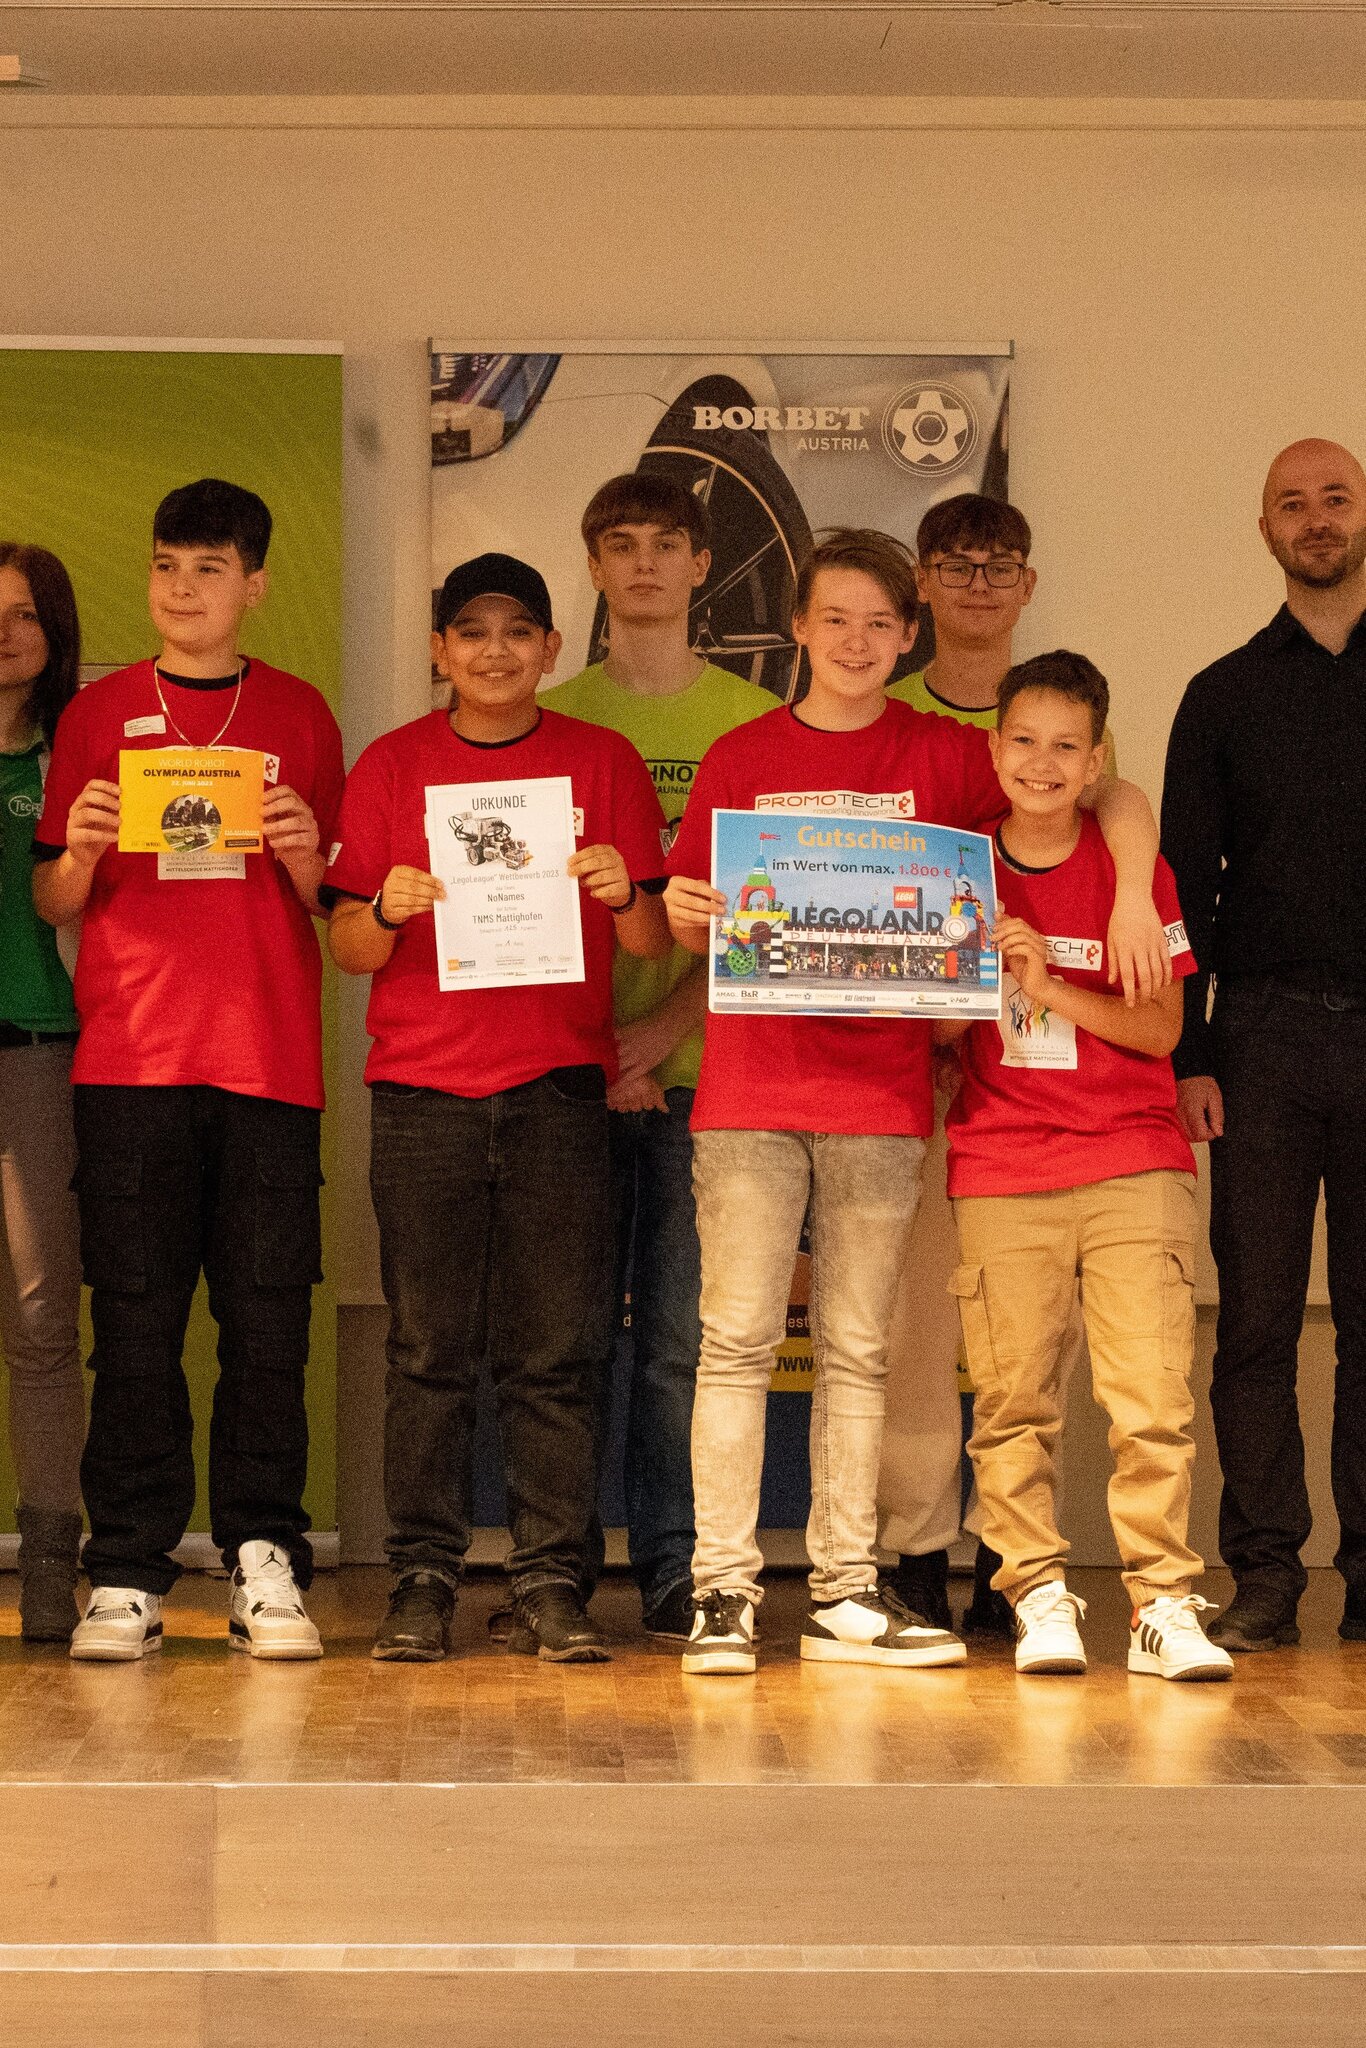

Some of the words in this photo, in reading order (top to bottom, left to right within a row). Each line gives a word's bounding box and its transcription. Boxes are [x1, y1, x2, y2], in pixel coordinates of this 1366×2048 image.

[692, 406, 870, 431] BORBET
[797, 437, 870, 451] AUSTRIA
[158, 759, 192, 767] WORLD
[194, 759, 226, 767] ROBOT
[143, 769, 196, 777] OLYMPIAD
[198, 769, 241, 778] AUSTRIA
[471, 794, 527, 811] URKUNDE
[757, 793, 895, 809] PROMOTECH
[797, 826, 927, 853] Gutschein
[499, 871, 541, 881] Wettbewerb
[542, 869, 560, 878] 2023
[772, 858, 789, 871] im
[793, 860, 828, 872] Wert
[832, 863, 858, 873] von
[861, 864, 895, 875] max.
[899, 863, 940, 878] 1.800
[487, 893, 525, 902] NoNames
[895, 892, 915, 902] LEGO
[472, 914, 494, 924] TNMS
[495, 911, 543, 923] Mattighofen
[786, 890, 944, 934] LEGOLAND
[790, 931, 946, 945] DEUTSCHLAND
[741, 990, 759, 998] B&R
